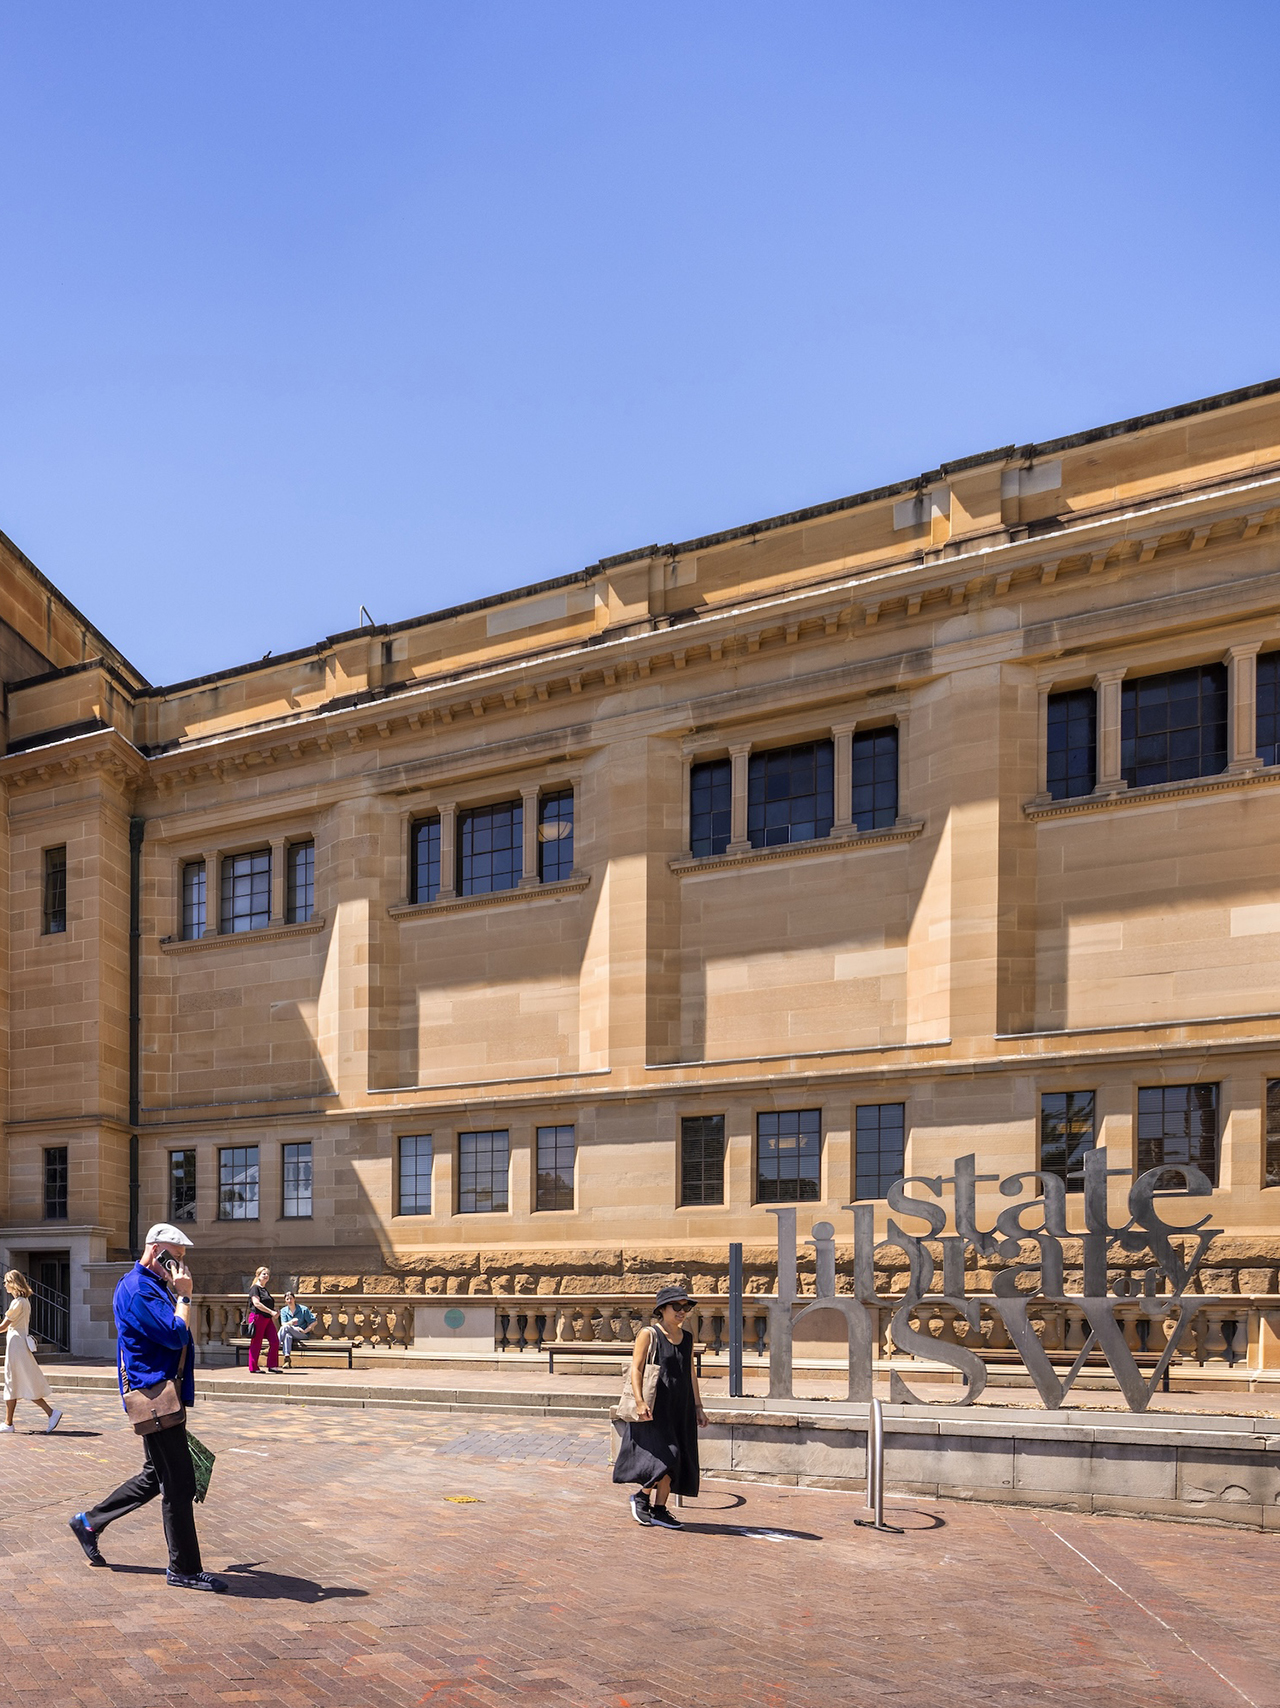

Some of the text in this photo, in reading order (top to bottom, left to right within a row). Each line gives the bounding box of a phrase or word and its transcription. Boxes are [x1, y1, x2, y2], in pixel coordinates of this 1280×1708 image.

[887, 1146, 1214, 1240] state
[765, 1204, 1225, 1314] library
[753, 1296, 1221, 1413] nsw
